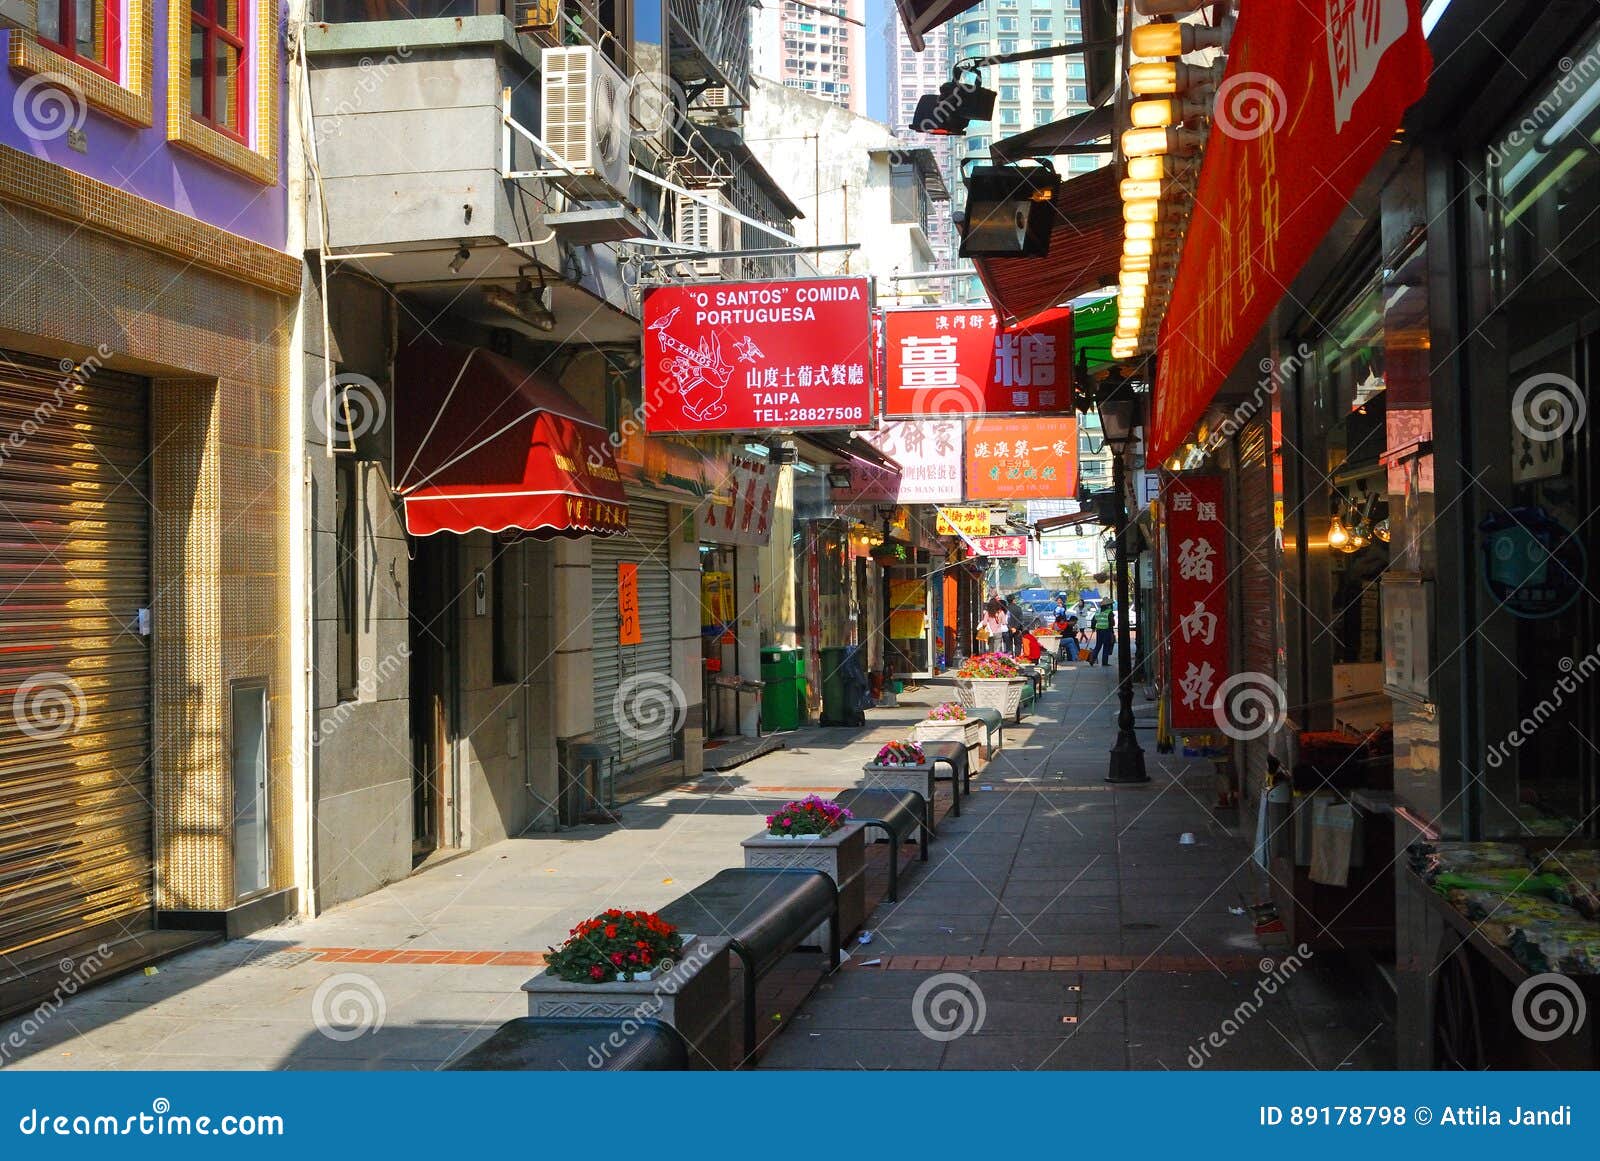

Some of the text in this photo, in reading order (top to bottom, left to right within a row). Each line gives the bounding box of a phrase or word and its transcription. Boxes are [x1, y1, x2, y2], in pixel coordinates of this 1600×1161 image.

[796, 286, 861, 303] COMIDA
[696, 306, 816, 326] PORTUGUESA
[936, 313, 1018, 330] 澳門街手
[746, 364, 864, 389] 山度士葡式餐廳
[753, 393, 800, 406] TAIPA
[753, 406, 862, 423] TEL:28827508
